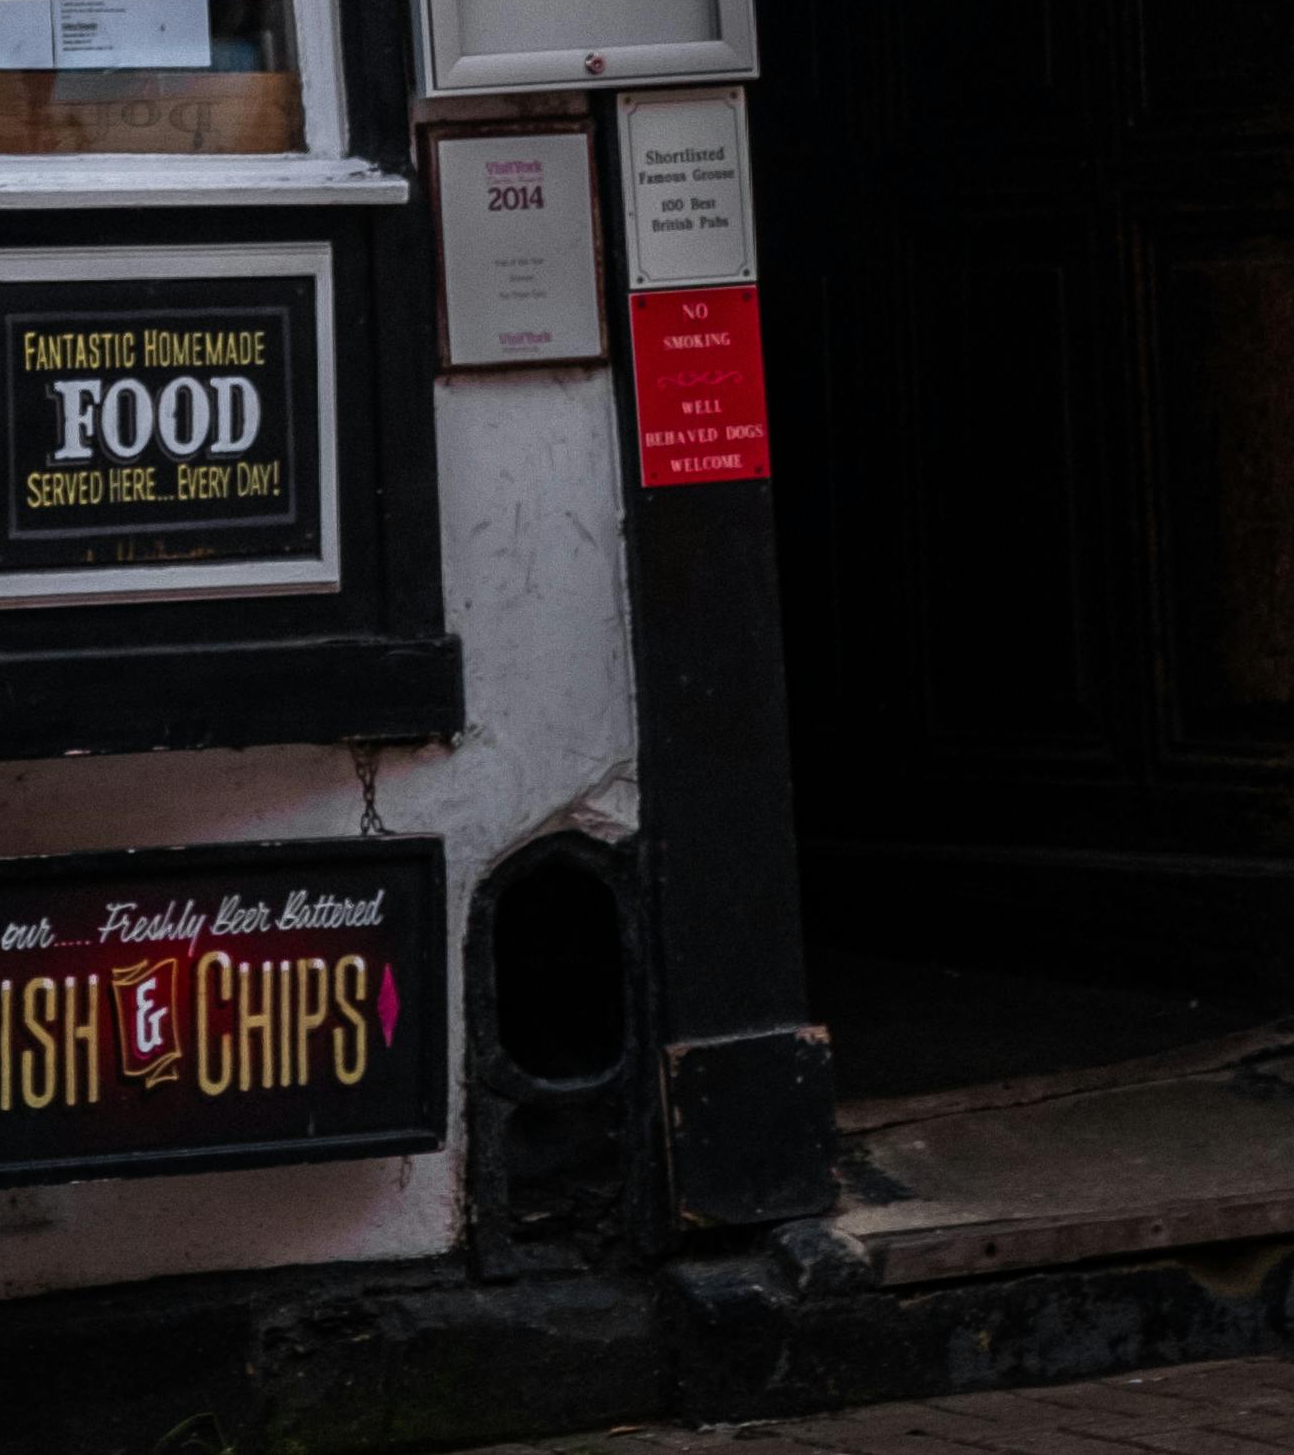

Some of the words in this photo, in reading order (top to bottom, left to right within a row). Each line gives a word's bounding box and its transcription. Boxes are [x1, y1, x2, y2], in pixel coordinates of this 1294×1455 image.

[645, 147, 725, 165] Shortlisted
[639, 171, 687, 185] Famous
[692, 169, 735, 182] Grouse
[488, 185, 544, 212] 2014
[662, 198, 685, 212] 100
[690, 197, 717, 211] Best
[652, 217, 694, 233] British
[698, 216, 729, 230] Pubs
[682, 302, 709, 320] NO
[23, 331, 137, 372] FANTASTIC
[143, 329, 267, 368] HOMEMADE
[662, 332, 732, 350] SMOKING
[53, 375, 263, 460] FOOD
[681, 399, 723, 415] WELL
[644, 426, 720, 449] BEHAVED
[725, 423, 765, 441] DOGS
[670, 452, 744, 473] WELCOME
[26, 470, 104, 510] SERVED
[236, 458, 282, 499] DAY!
[98, 898, 208, 958] Freshly
[208, 893, 273, 936] Beer
[275, 888, 387, 931] Battered
[134, 977, 169, 1055] &
[194, 949, 369, 1099] CHIPS
